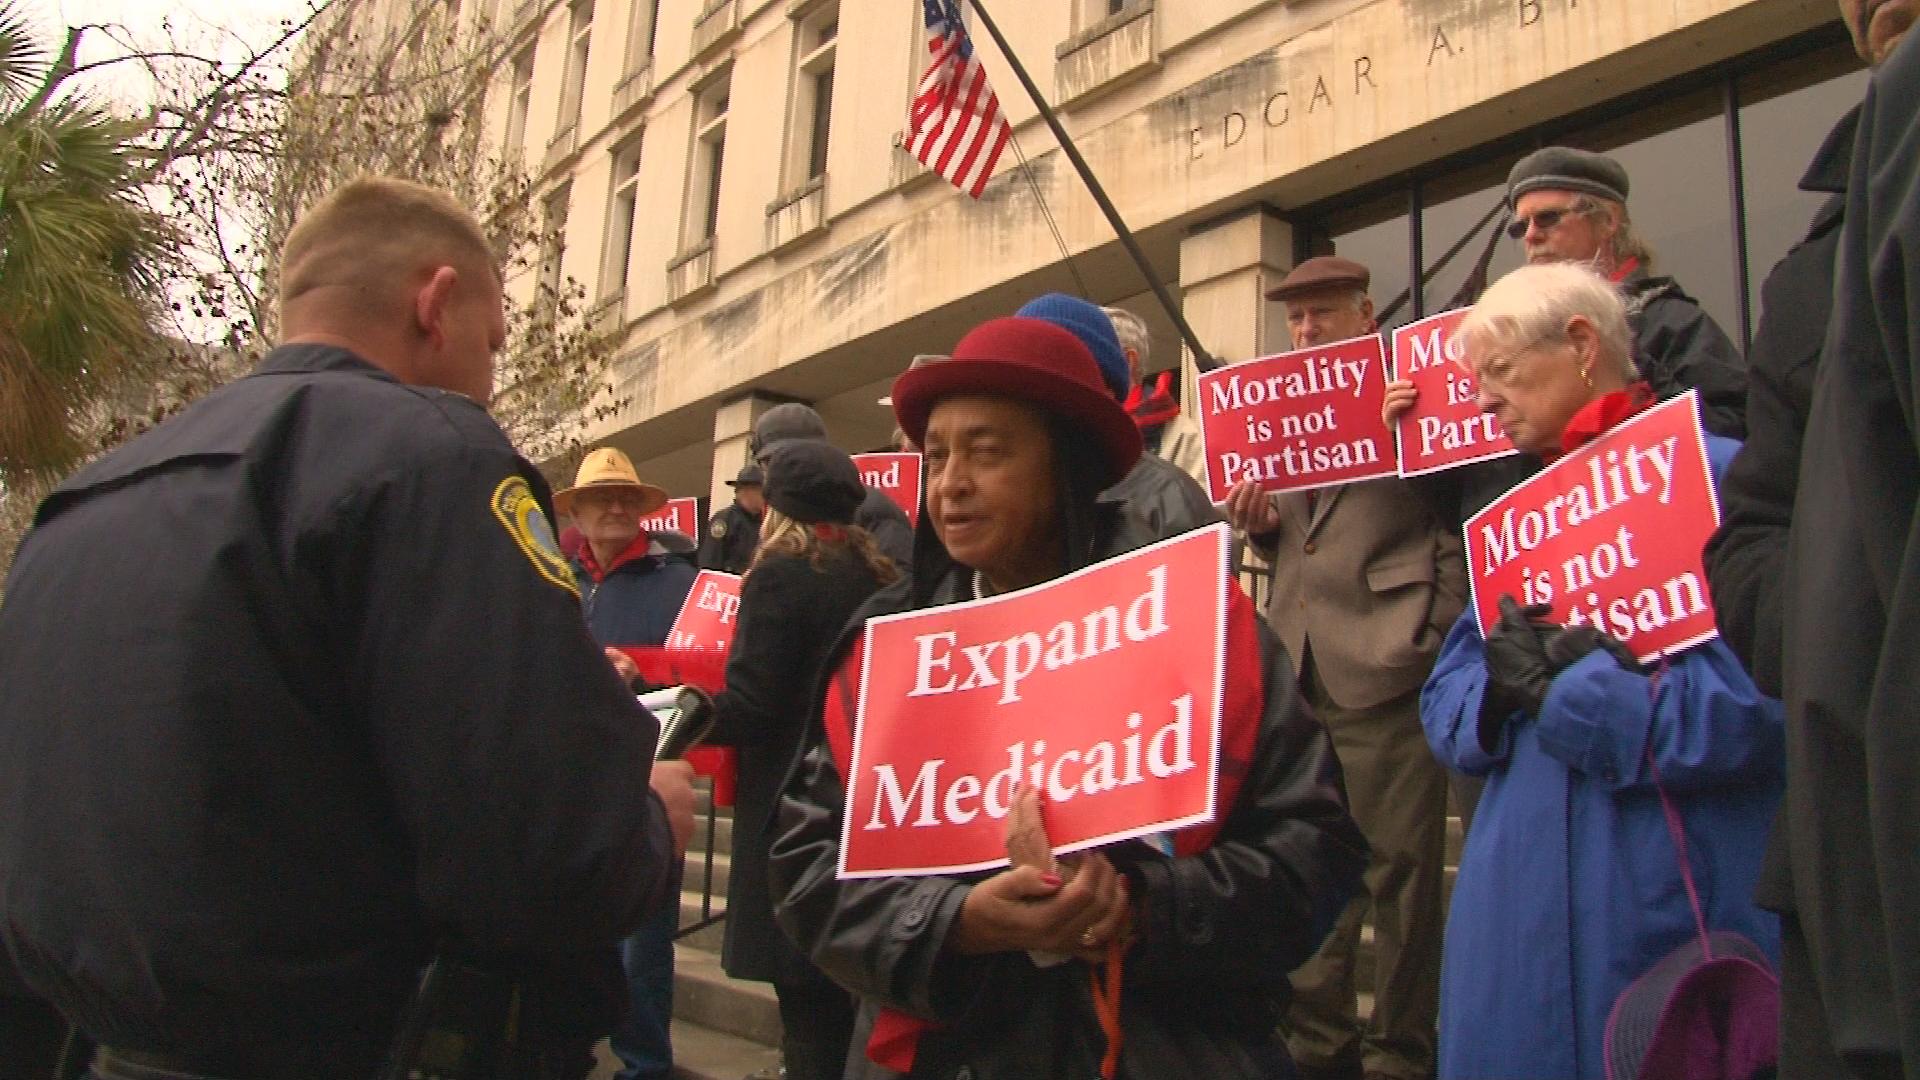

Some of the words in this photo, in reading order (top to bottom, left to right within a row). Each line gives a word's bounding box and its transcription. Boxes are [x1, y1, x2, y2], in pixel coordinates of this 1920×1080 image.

[1186, 56, 1379, 163] EDGAR
[1426, 24, 1465, 66] A.
[1209, 357, 1370, 416] Morality
[1445, 372, 1472, 406] is
[1245, 415, 1273, 444] is
[1280, 404, 1338, 439] not
[858, 460, 900, 489] nd
[1219, 436, 1380, 488] Partisan
[1480, 436, 1679, 578] Morality
[1521, 566, 1553, 606] is
[1560, 524, 1641, 594] not
[906, 563, 1171, 706] Expand
[863, 692, 1198, 832] Medicaid
